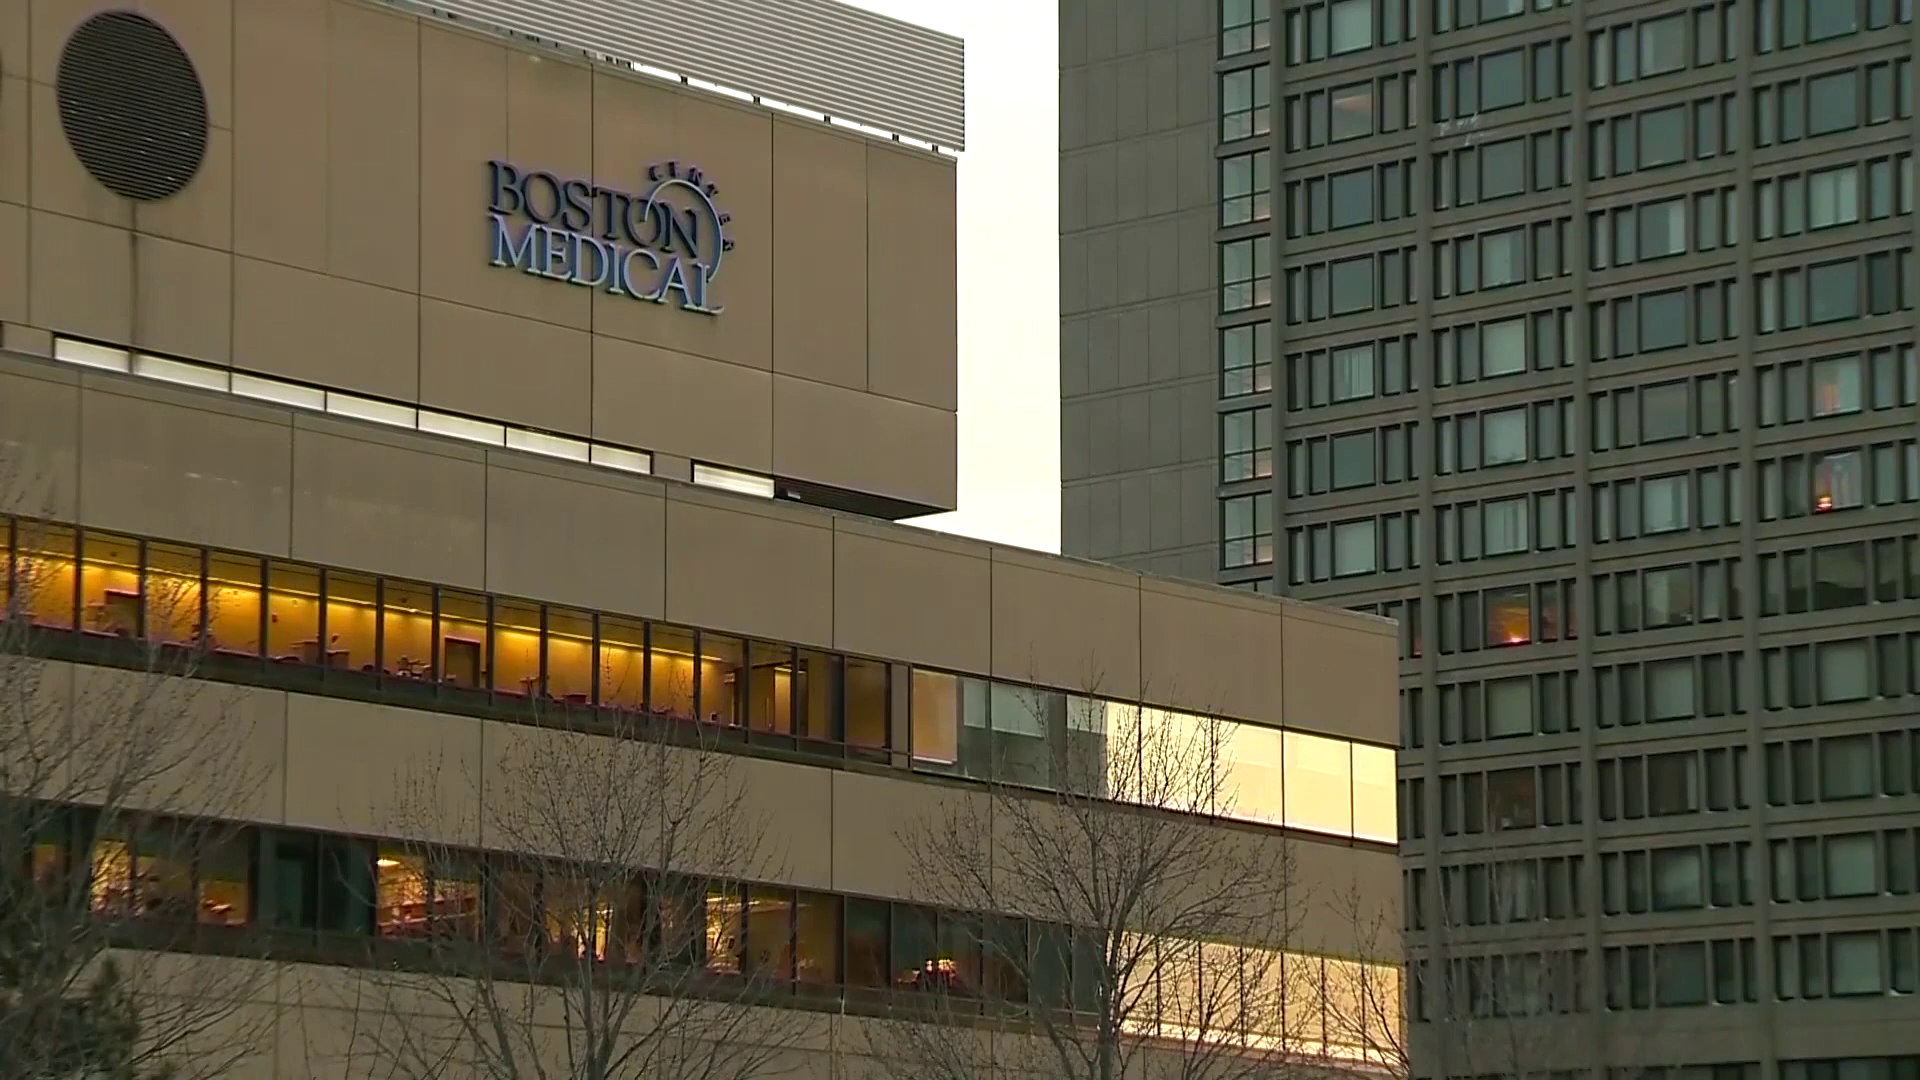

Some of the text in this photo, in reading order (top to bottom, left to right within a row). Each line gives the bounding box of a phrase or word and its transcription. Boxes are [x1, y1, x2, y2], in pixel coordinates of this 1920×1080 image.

[488, 160, 698, 259] BOSTON
[646, 161, 735, 254] CENTER
[488, 214, 725, 316] MEDICAL
